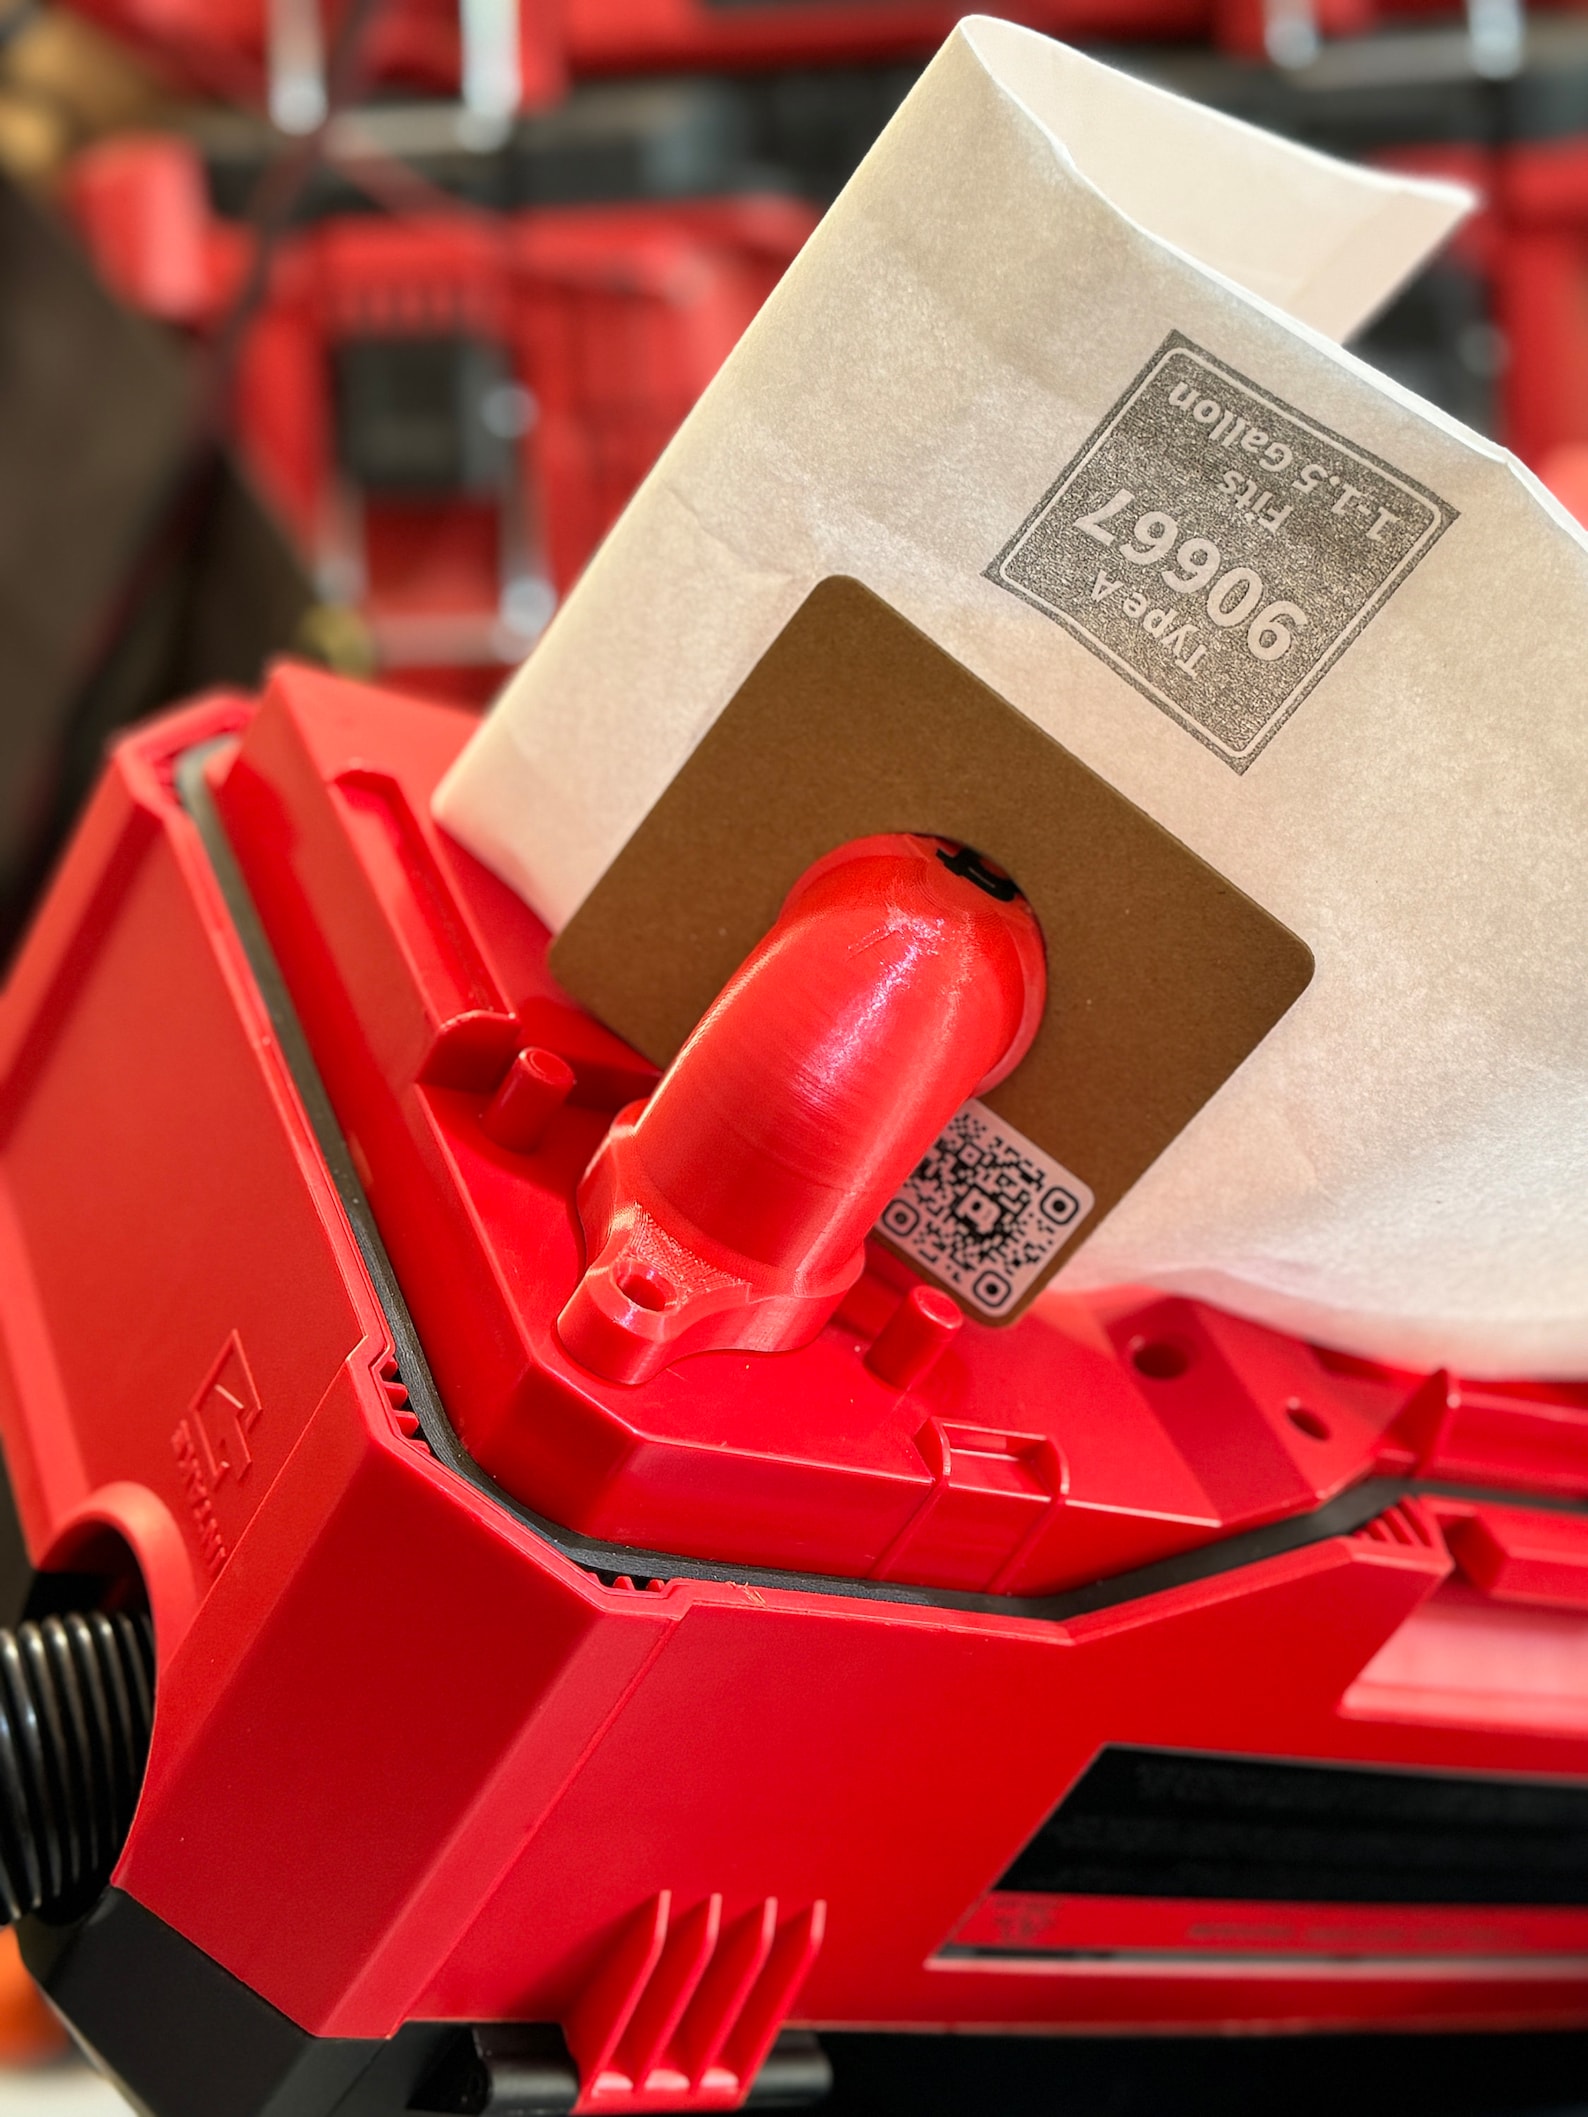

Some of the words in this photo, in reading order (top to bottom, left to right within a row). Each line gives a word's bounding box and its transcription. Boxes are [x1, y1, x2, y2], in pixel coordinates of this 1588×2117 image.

[1169, 383, 1294, 471] Gallon
[1219, 469, 1293, 533] Fits
[1294, 463, 1401, 542] 1-1.5
[1074, 488, 1308, 661] 90667
[1091, 571, 1120, 602] A
[1122, 592, 1207, 677] Type
[171, 1419, 227, 1575] INTAKE
